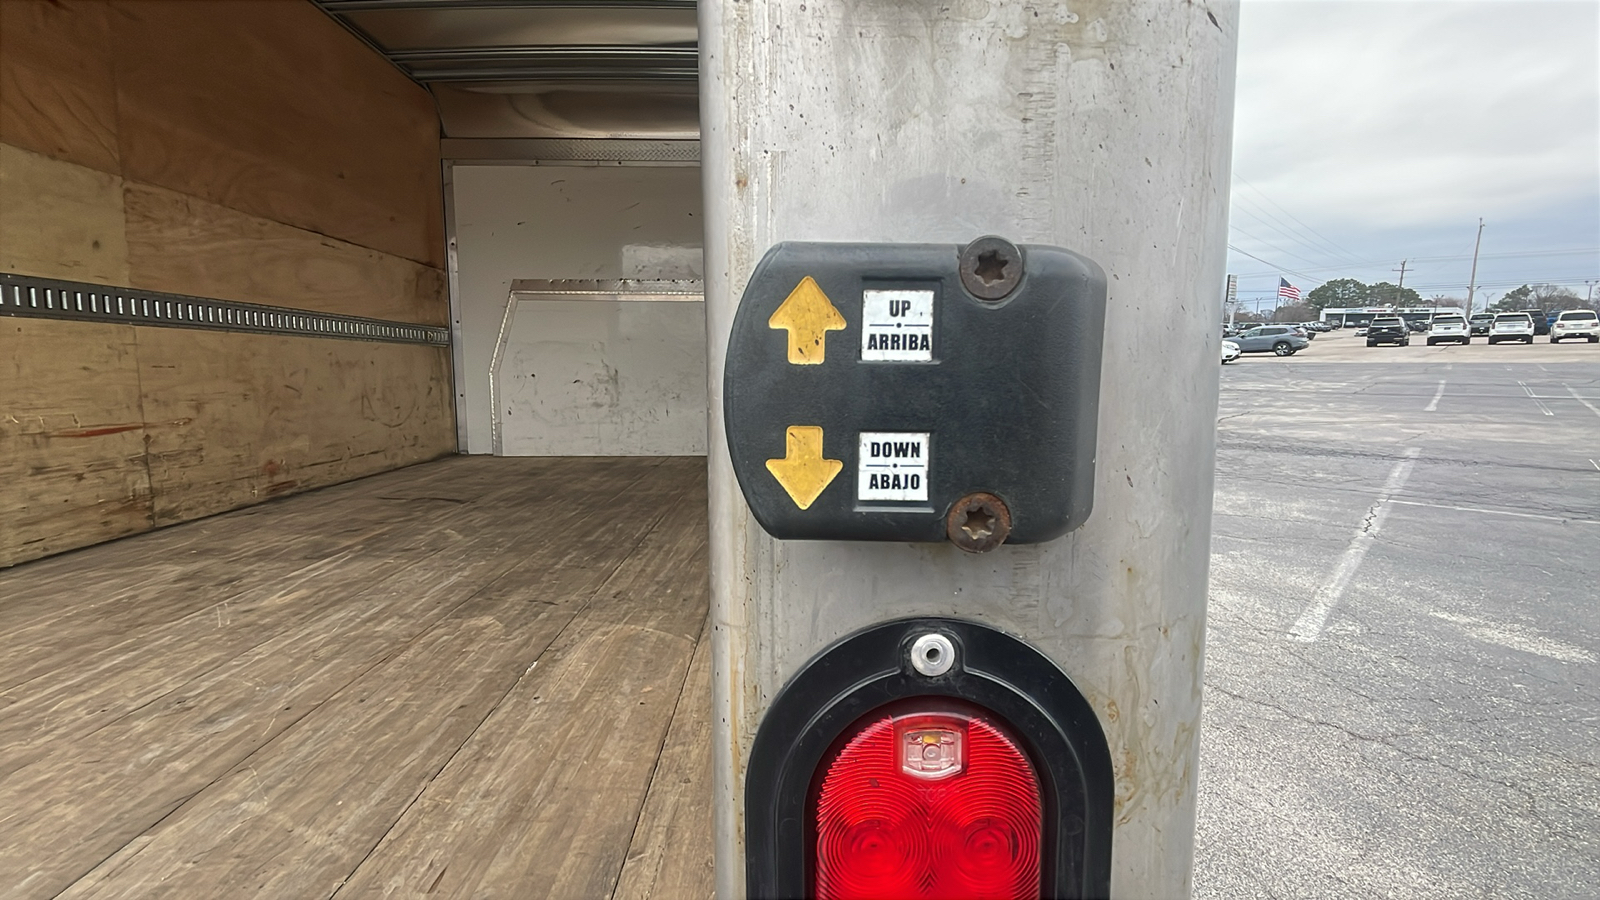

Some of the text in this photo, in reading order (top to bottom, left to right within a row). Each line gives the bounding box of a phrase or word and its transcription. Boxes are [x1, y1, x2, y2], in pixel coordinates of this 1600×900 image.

[889, 300, 911, 317] UP
[867, 333, 930, 351] ARRIBA
[870, 441, 920, 458] DOWN
[869, 473, 920, 490] ABAJO
